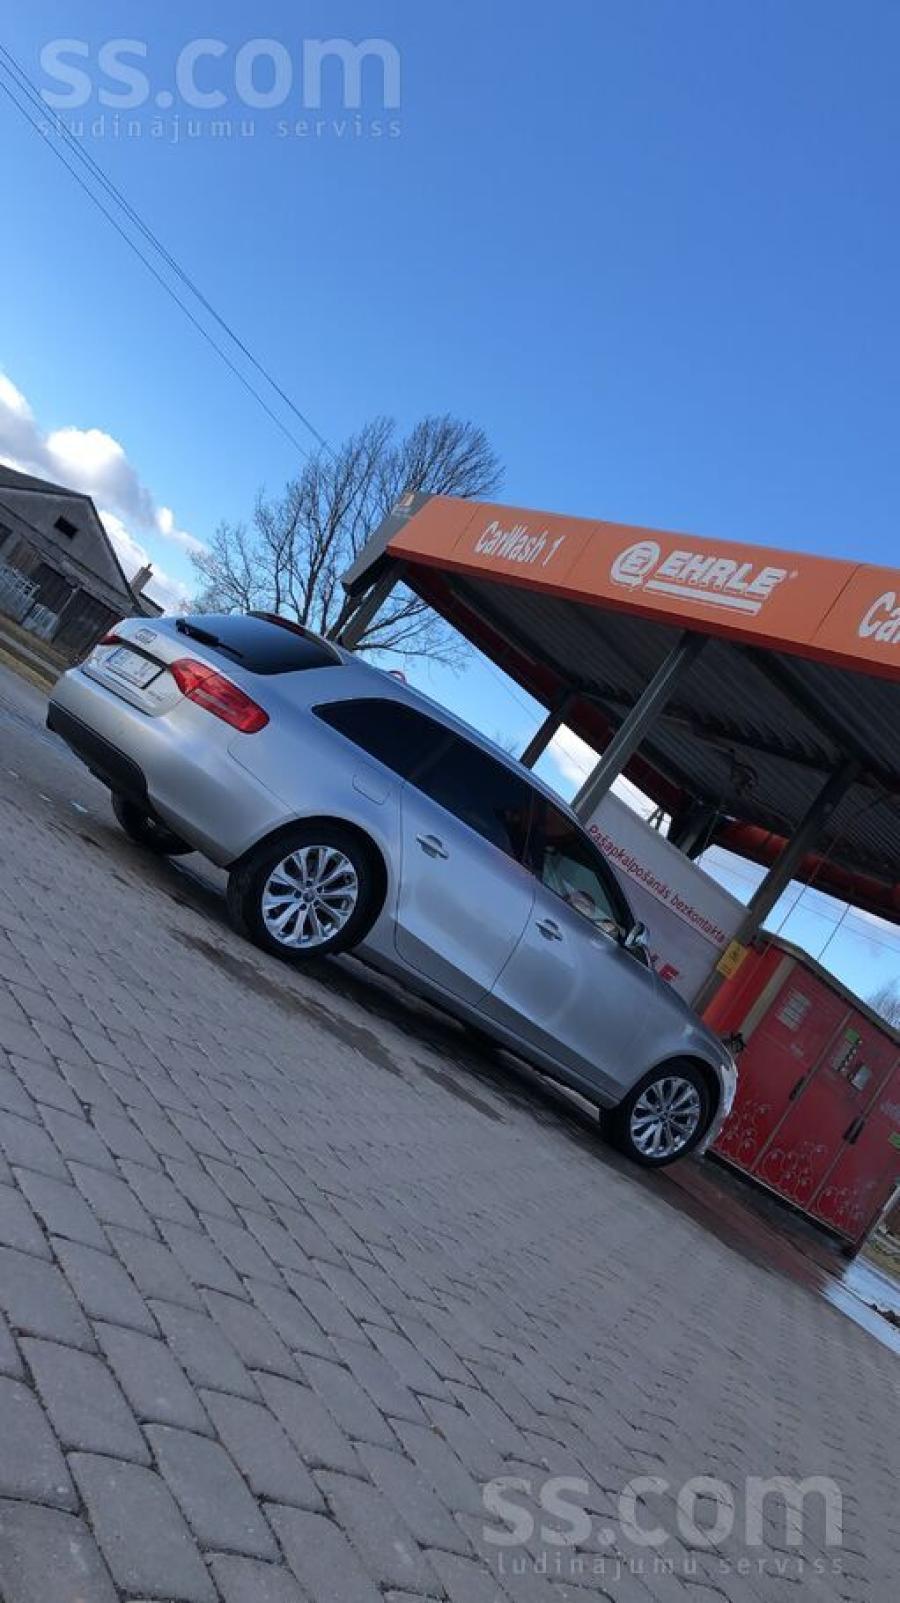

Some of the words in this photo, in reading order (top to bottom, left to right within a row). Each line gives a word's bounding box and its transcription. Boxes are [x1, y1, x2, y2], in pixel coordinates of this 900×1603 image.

[474, 520, 548, 563] CarWash
[542, 533, 566, 568] 1
[653, 550, 788, 600] EHRLE
